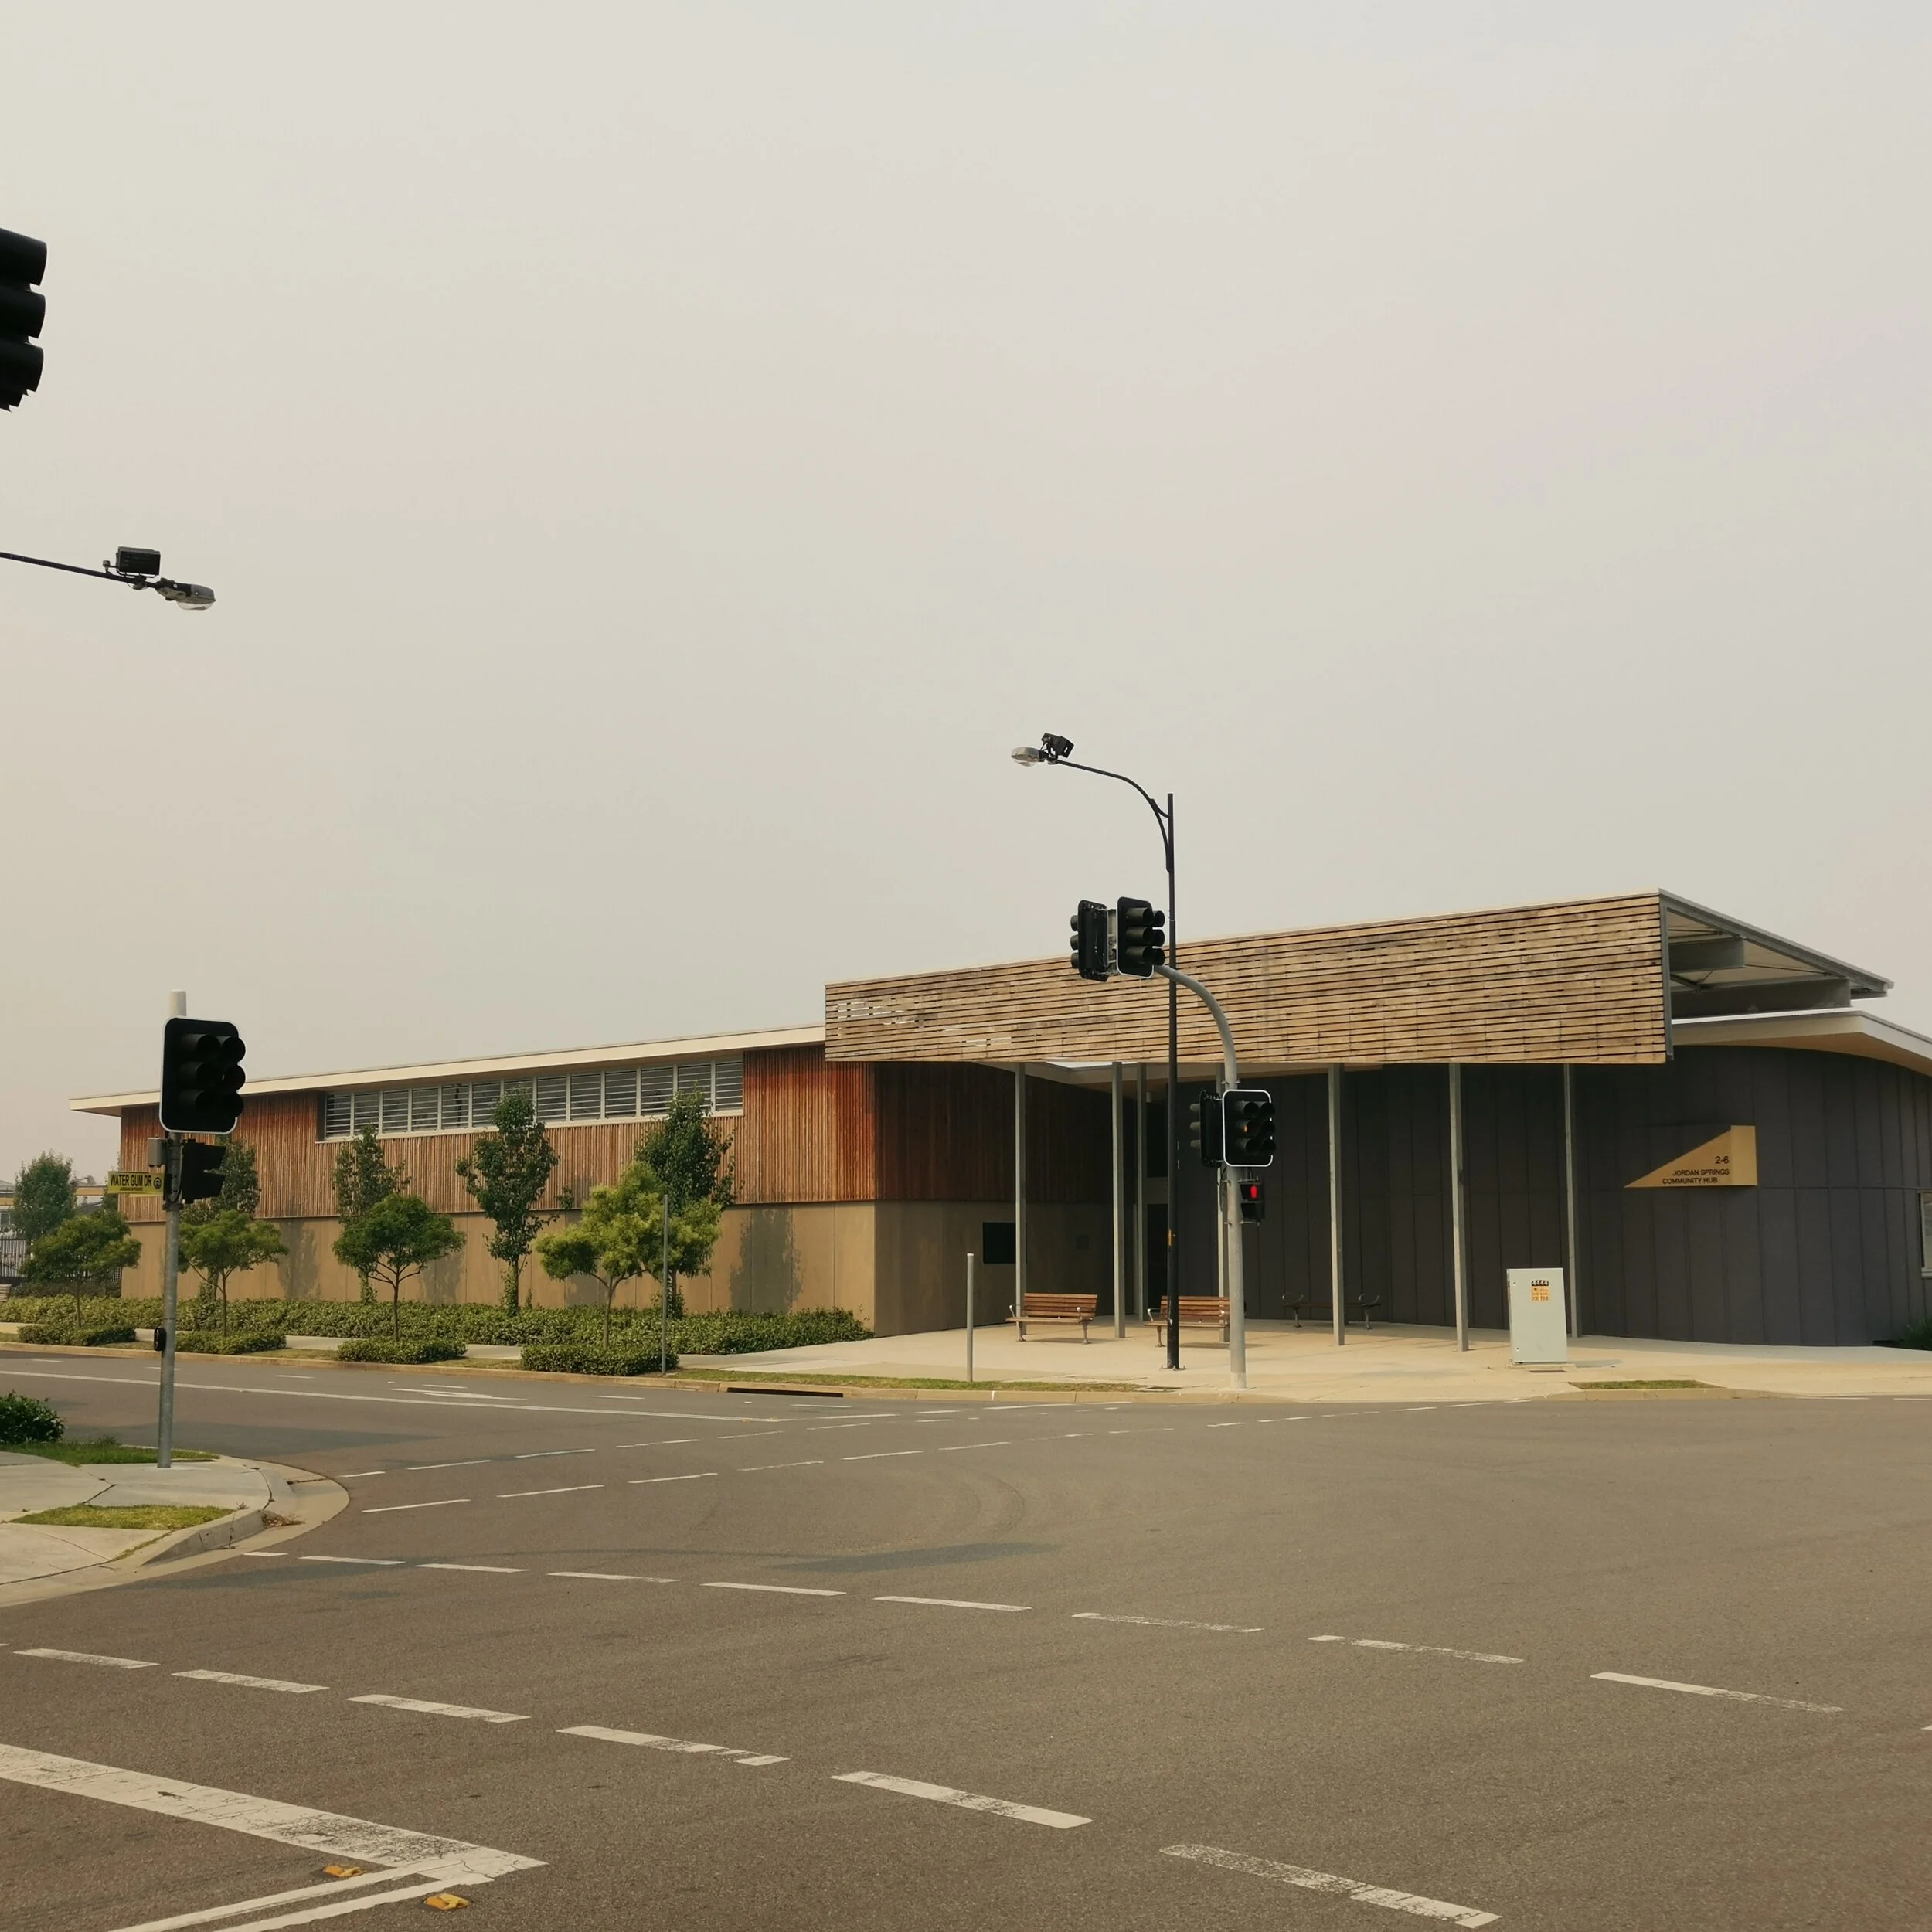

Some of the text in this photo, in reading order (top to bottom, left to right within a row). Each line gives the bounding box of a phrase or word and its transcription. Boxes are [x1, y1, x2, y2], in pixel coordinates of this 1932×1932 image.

[110, 1174, 152, 1187] WATER GUM DR
